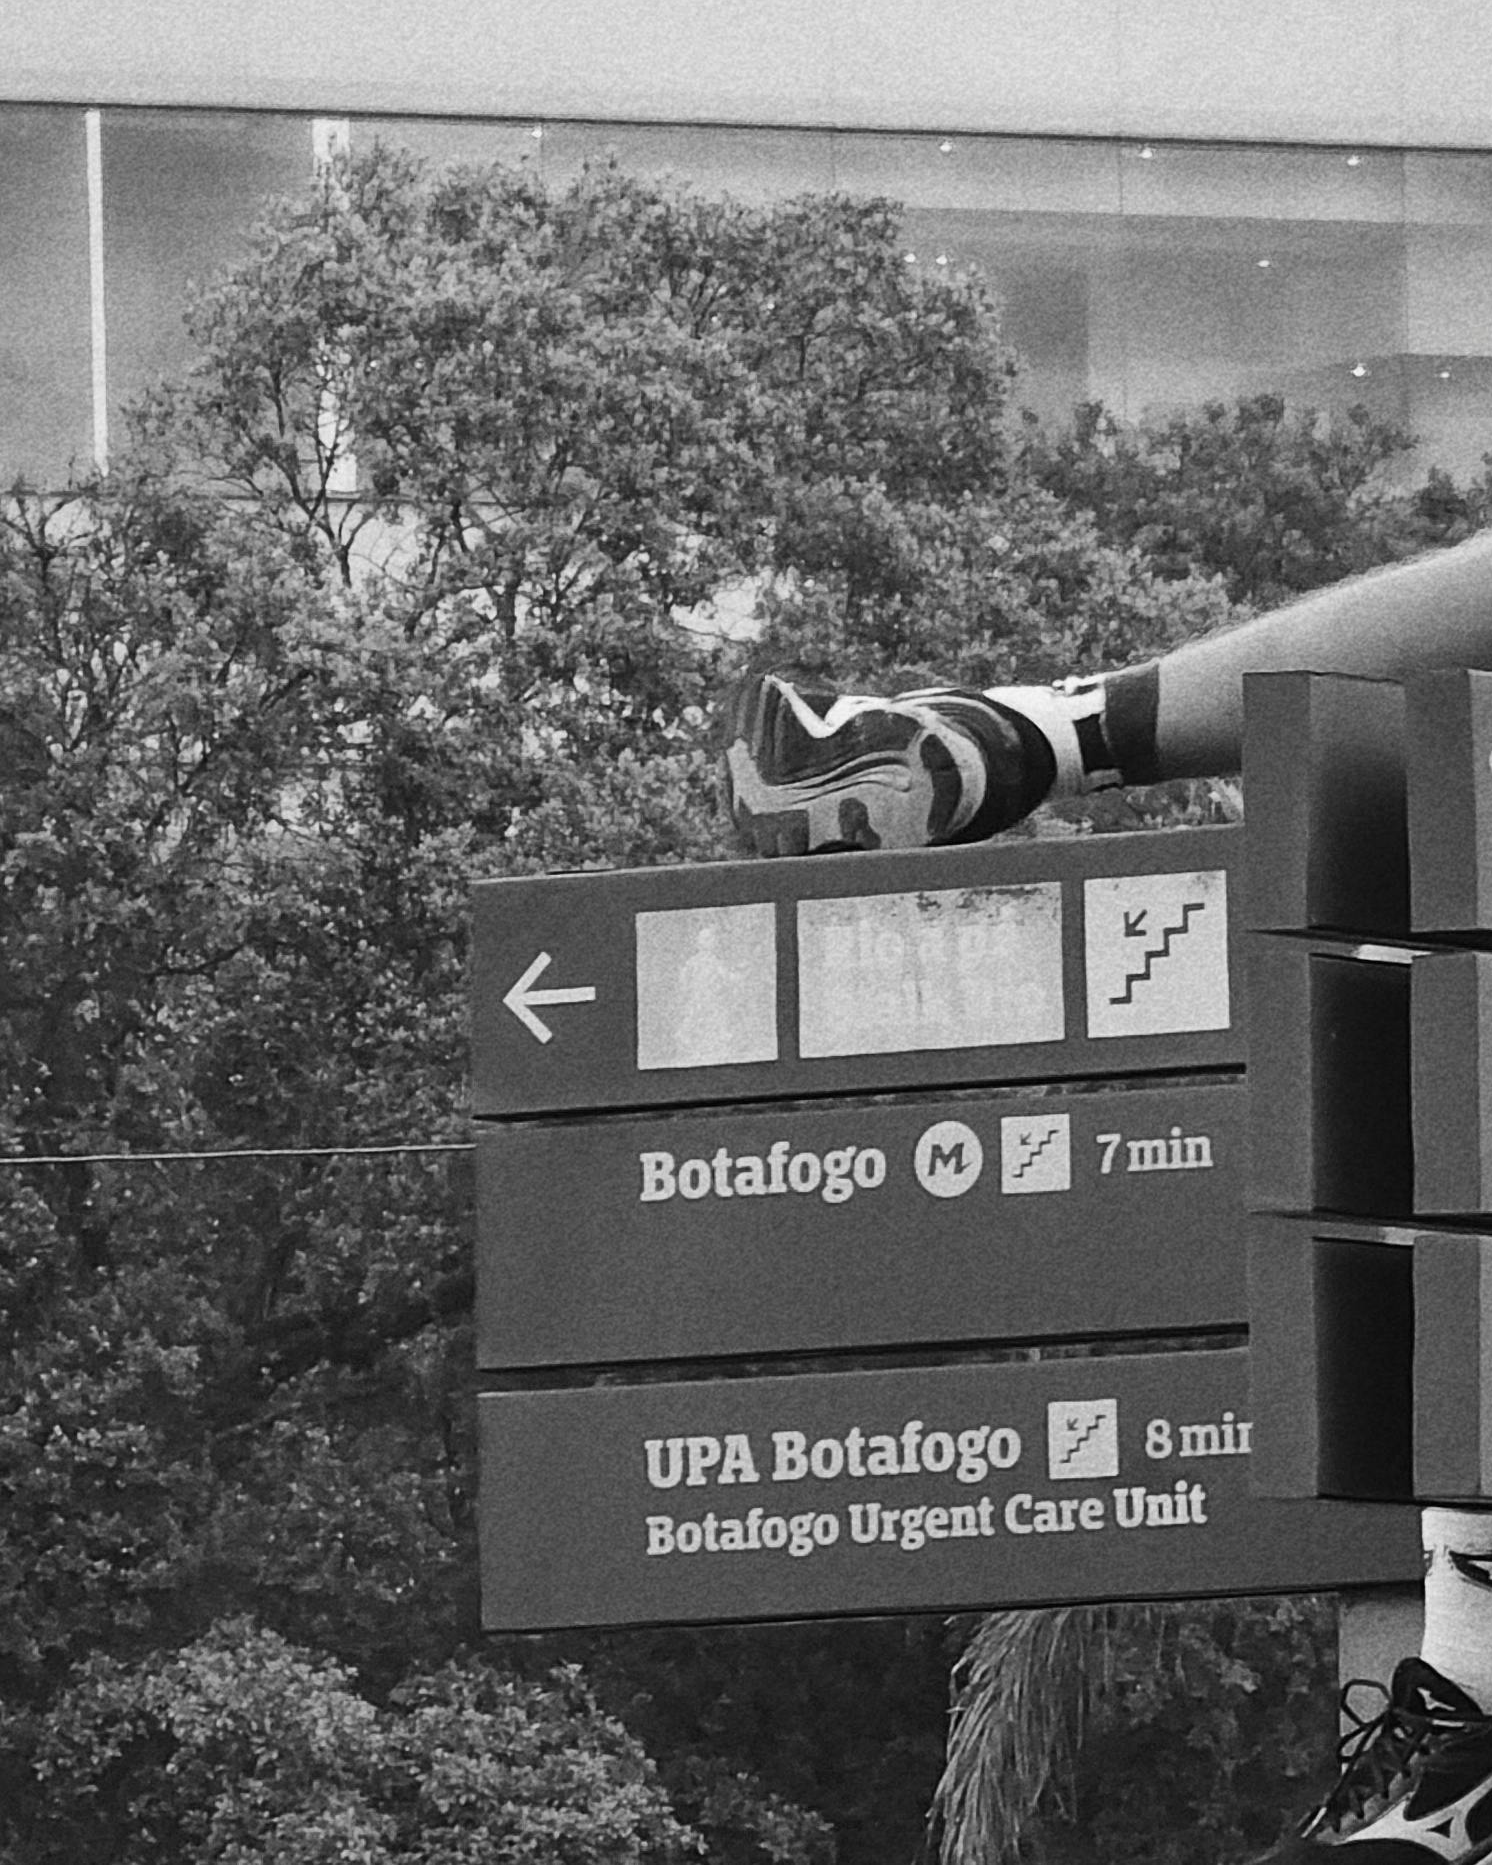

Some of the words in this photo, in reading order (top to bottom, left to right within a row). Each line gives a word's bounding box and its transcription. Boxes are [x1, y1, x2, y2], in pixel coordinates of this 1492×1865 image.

[639, 1141, 887, 1203] Botafogo
[644, 1433, 760, 1489] UPA
[771, 1420, 1021, 1483] Botafogo
[645, 1507, 840, 1557] Botafogo
[848, 1496, 995, 1551] Urgent
[1004, 1493, 1104, 1534] Care
[1113, 1480, 1208, 1527] Unit
